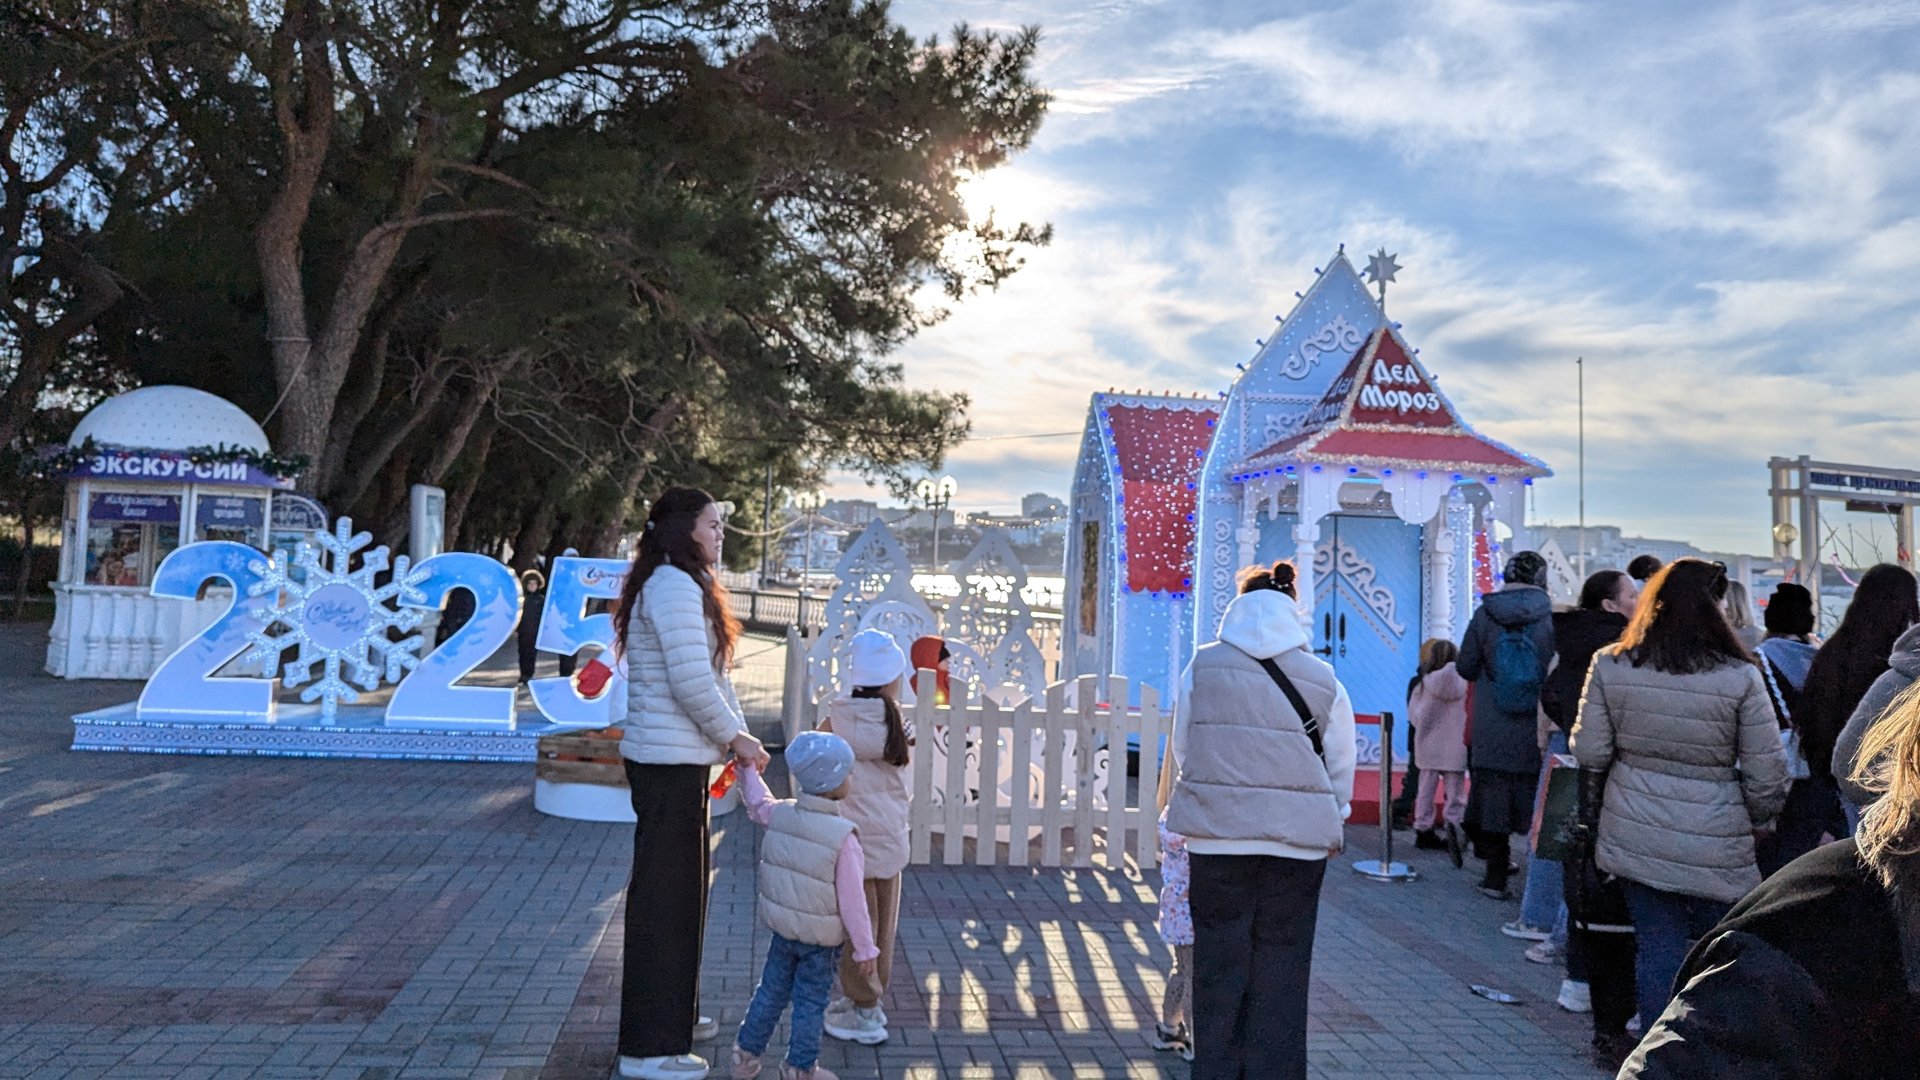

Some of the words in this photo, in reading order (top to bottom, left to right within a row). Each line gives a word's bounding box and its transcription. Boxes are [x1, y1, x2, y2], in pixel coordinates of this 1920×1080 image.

[1373, 359, 1421, 386] Дед
[1359, 384, 1440, 413] Мороз
[90, 456, 248, 481] ЭКСКУРСИИ
